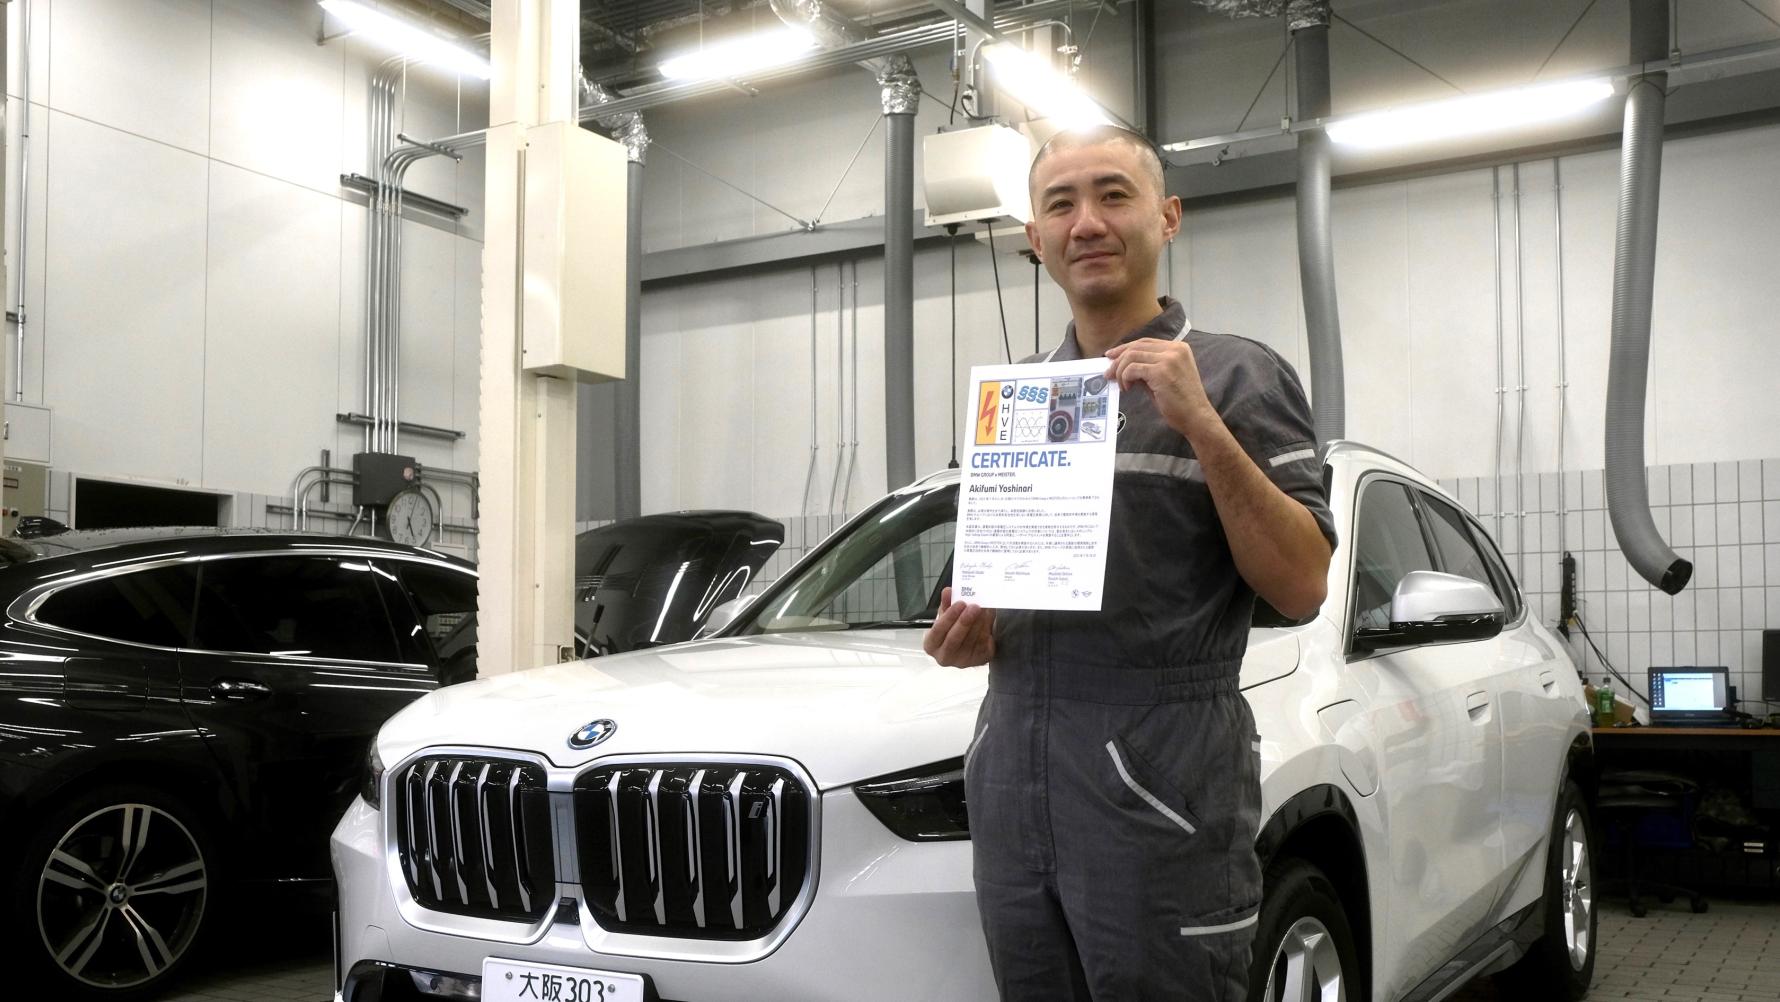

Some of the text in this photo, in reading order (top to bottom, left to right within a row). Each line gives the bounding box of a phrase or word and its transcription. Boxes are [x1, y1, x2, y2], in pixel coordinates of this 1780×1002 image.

[972, 451, 1071, 468] CERTIFICATE.
[969, 483, 1033, 493] Akifumi Yoshinari
